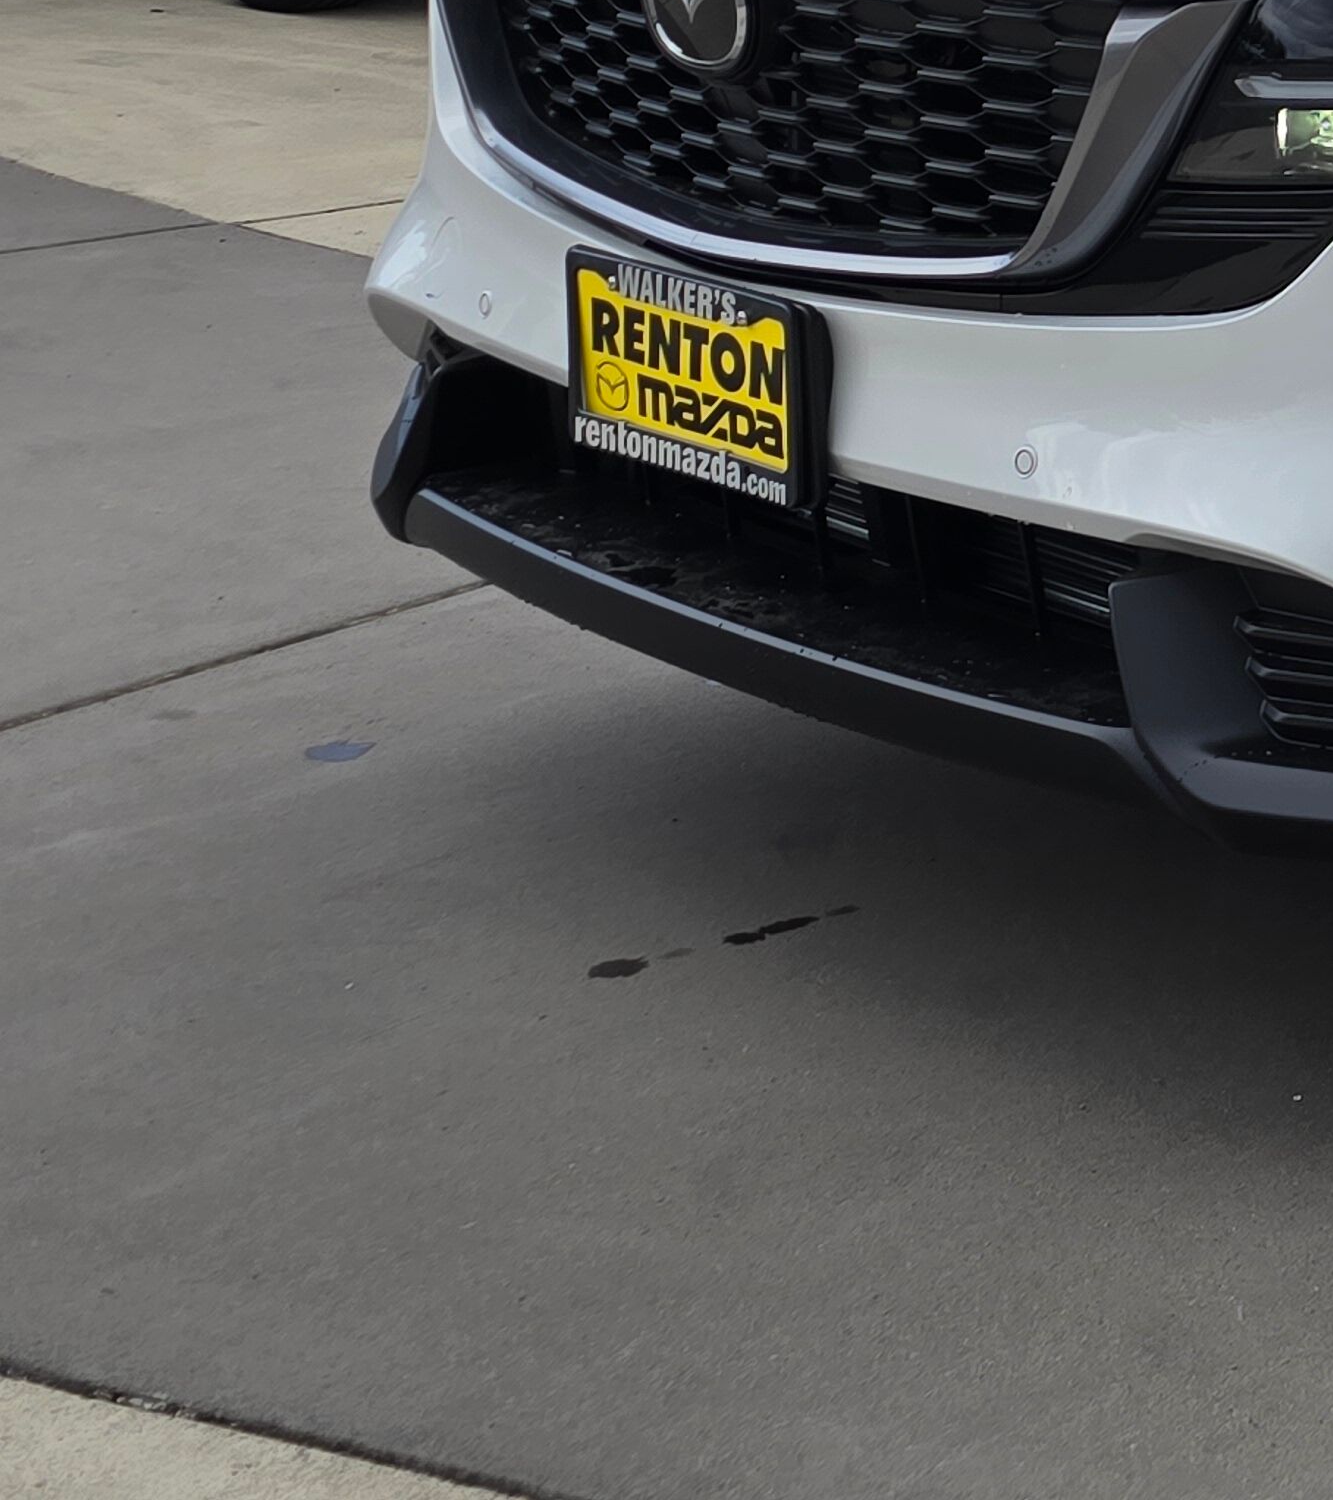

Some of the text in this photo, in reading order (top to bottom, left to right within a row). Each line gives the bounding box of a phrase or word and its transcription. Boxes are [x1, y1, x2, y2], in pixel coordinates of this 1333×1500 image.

[617, 264, 736, 326] WALKER'S
[591, 297, 786, 405] RENTON
[574, 415, 787, 506] rentonmazda.com
